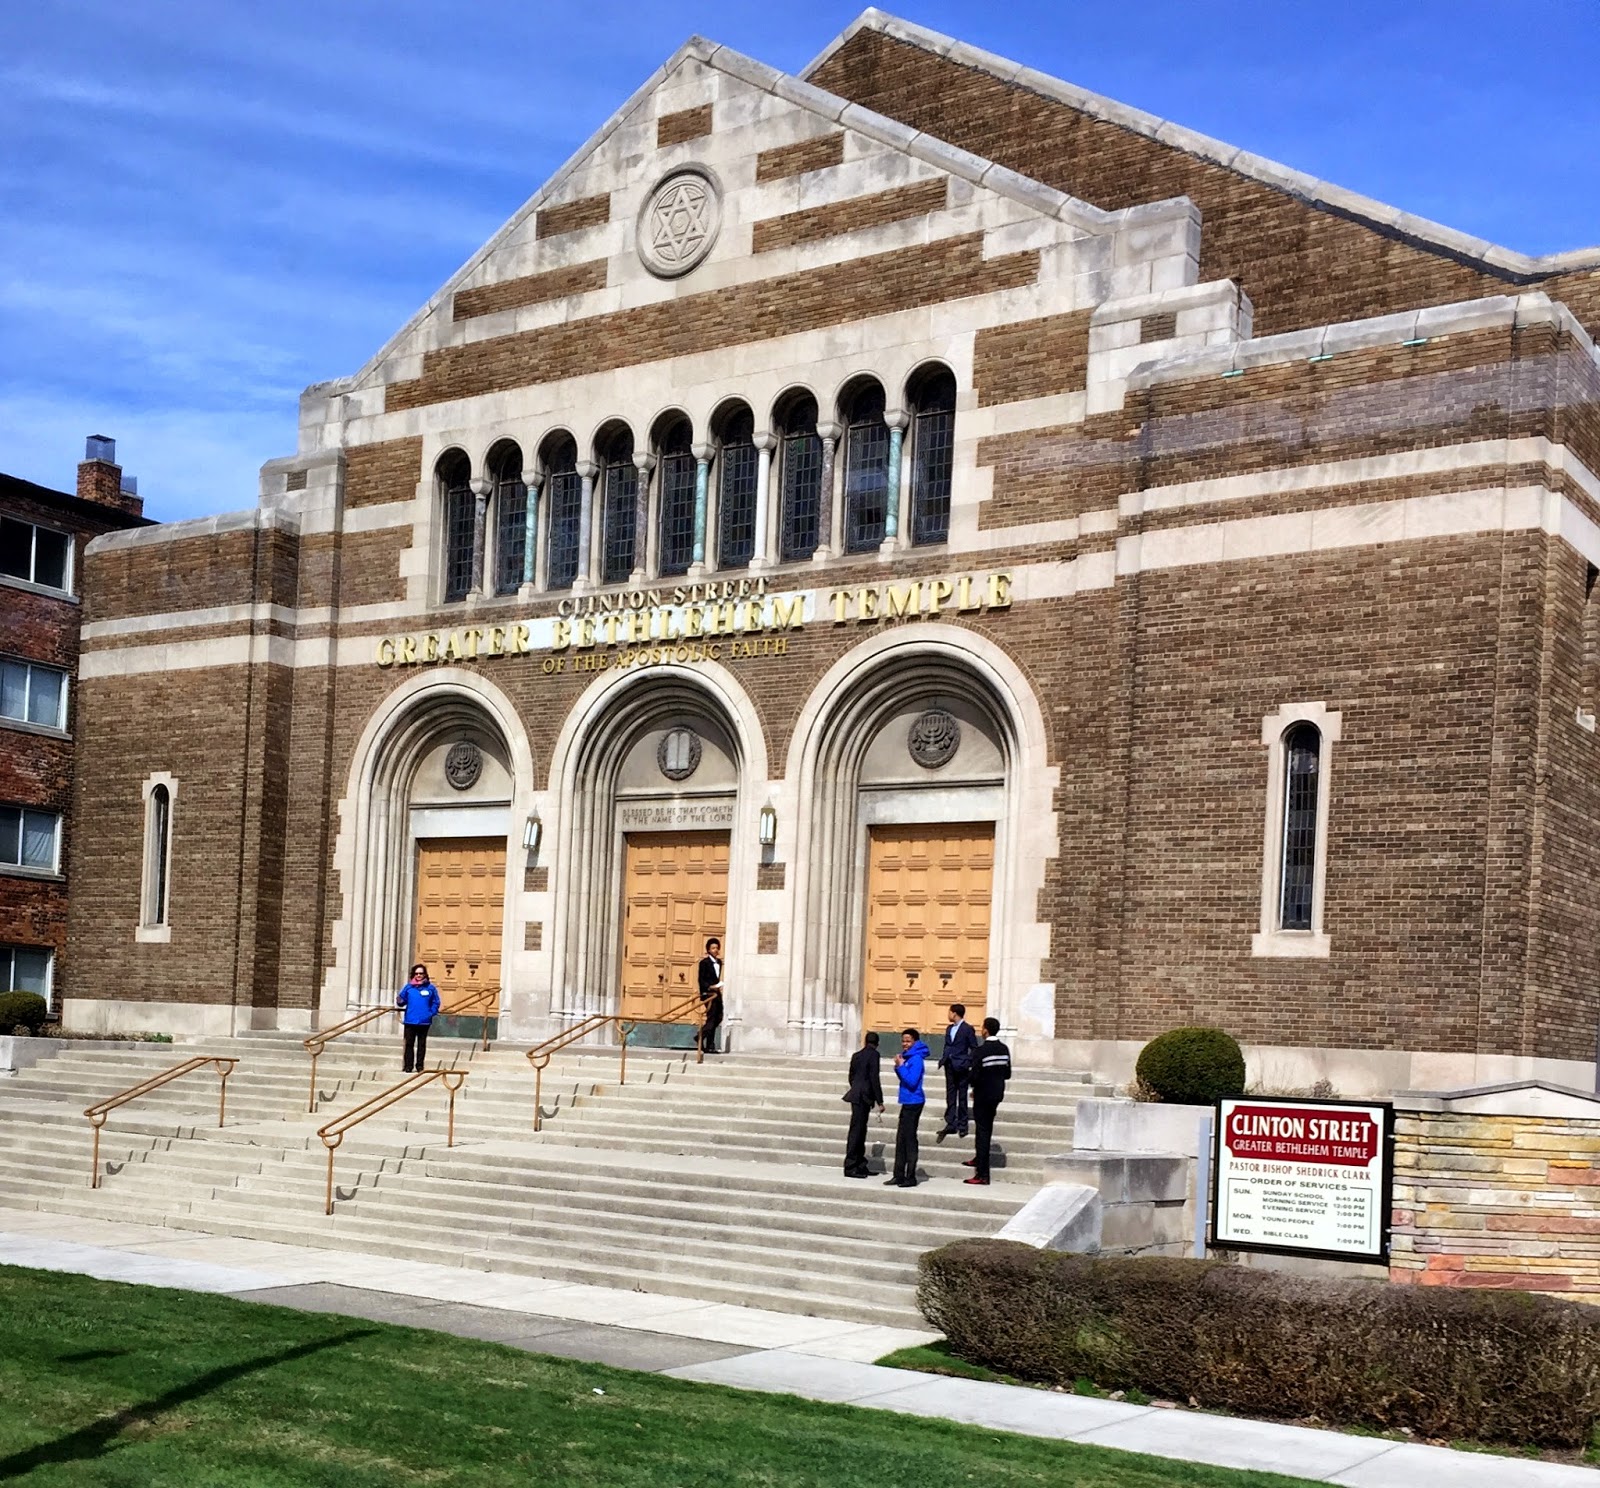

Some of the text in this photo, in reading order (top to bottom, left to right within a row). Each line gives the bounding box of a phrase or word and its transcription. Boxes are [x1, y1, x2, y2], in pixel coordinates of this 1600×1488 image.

[558, 577, 768, 617] CLINTON STREET
[376, 573, 1013, 667] GREATER BETHLEHEM TEMPLE
[543, 638, 789, 674] OF THE APOSTOLIC FAITH
[622, 808, 652, 818] BLESSED
[655, 808, 664, 816] BE
[680, 807, 698, 815] THAT
[700, 805, 733, 814] COMETH
[634, 816, 648, 825] THE
[652, 815, 672, 824] NAME
[676, 815, 687, 823] OF
[709, 813, 733, 822] LORD
[1232, 1114, 1371, 1143] CLINTON STREET
[1232, 1139, 1368, 1159] GREATER BETHLEHEM TEMPLE
[1229, 1161, 1371, 1180] PASTOR BISHOP SHEDRICK CLARK
[1250, 1177, 1282, 1186] ORDER
[1299, 1181, 1348, 1191] SERVICES
[1233, 1187, 1252, 1195] SUN.
[1294, 1192, 1325, 1200] SCHOOL
[1262, 1197, 1296, 1205] MORNING
[1262, 1204, 1294, 1212] EVENING
[1295, 1207, 1326, 1215] SERVICE
[1261, 1215, 1287, 1223] YOUNG
[1288, 1218, 1315, 1226] PEOPLE
[1263, 1230, 1283, 1238] BIBLE
[1283, 1232, 1309, 1240] CLASS
